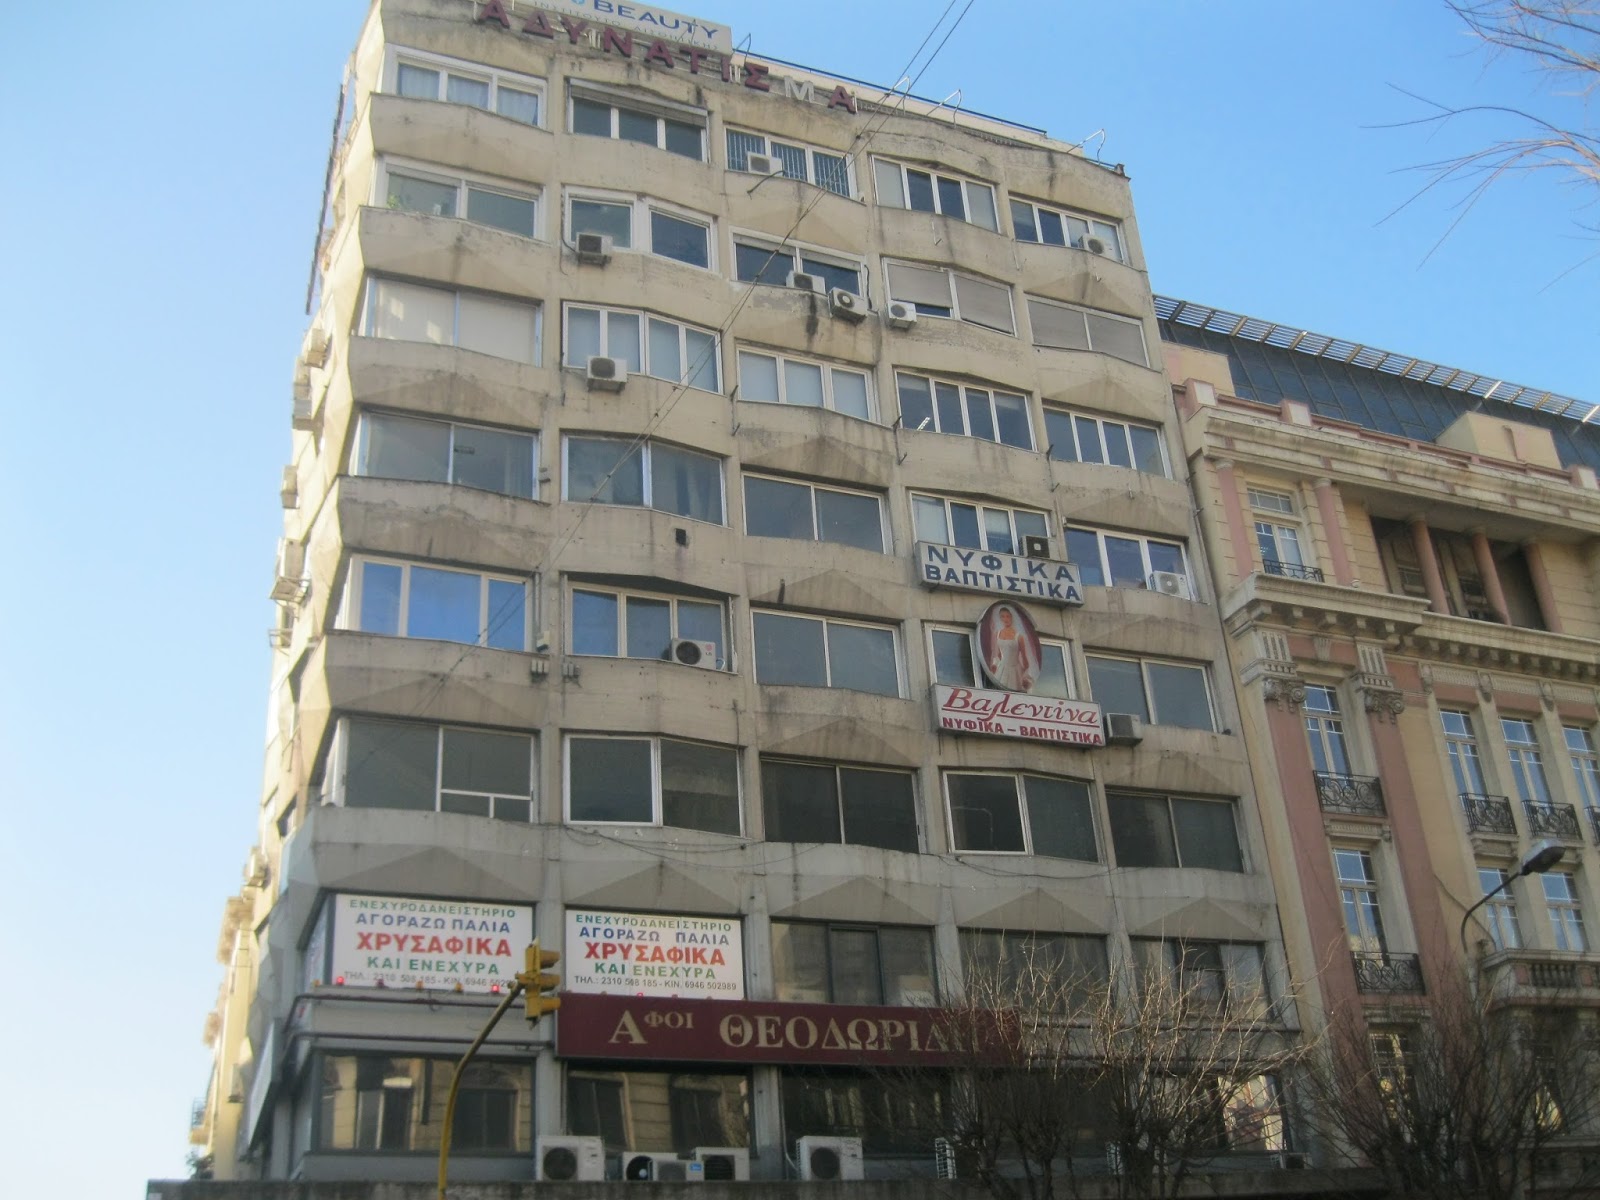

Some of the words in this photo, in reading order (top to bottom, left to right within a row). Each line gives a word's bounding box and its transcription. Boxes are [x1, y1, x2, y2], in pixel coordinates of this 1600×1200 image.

[594, 0, 719, 39] BEAUTY
[478, 0, 859, 114] ΑΔΥΝΑΤΙΣΜΑ
[927, 545, 1075, 582] ΝΥΦΙΚΑ
[925, 564, 1081, 601] ΒΑΠΤΙΣΤΙΚΑ
[942, 717, 1004, 734] ΝΥΦΙΚΑ
[1019, 726, 1102, 745] ΒΑΠΤΙΣΤΙΚΑ
[350, 900, 516, 918] ΕΝΕΧΥΡΟΔΑΝΕΙΣΤΗΡΙΟ
[356, 913, 446, 929] ΑΓΟΡΑΖΩ
[452, 918, 510, 933] ΠΑΛΙΑ
[575, 914, 732, 932] ΕΝΕΧΥΡΟΔΑΝΕΙΣΤΗΡΙΟ
[356, 931, 512, 957] ΧΡΥΣΑΦΙΚΑ
[579, 926, 660, 942] ΑΓΟΡΑΖΩ
[675, 932, 729, 945] ΠΑΛΙΑ
[584, 941, 726, 966] ΧΡΥΣΑΦΙΚΑ
[367, 956, 400, 970] ΚΑΙ
[409, 959, 499, 975] ΕΝΕΧΥΡΑ
[594, 962, 626, 975] ΚΑΙ
[633, 965, 716, 979] ΕΝΕΧΥΡΑ
[601, 976, 622, 985] 2310
[642, 979, 657, 987] 185
[685, 981, 704, 989] 6946
[707, 981, 737, 990] 502989
